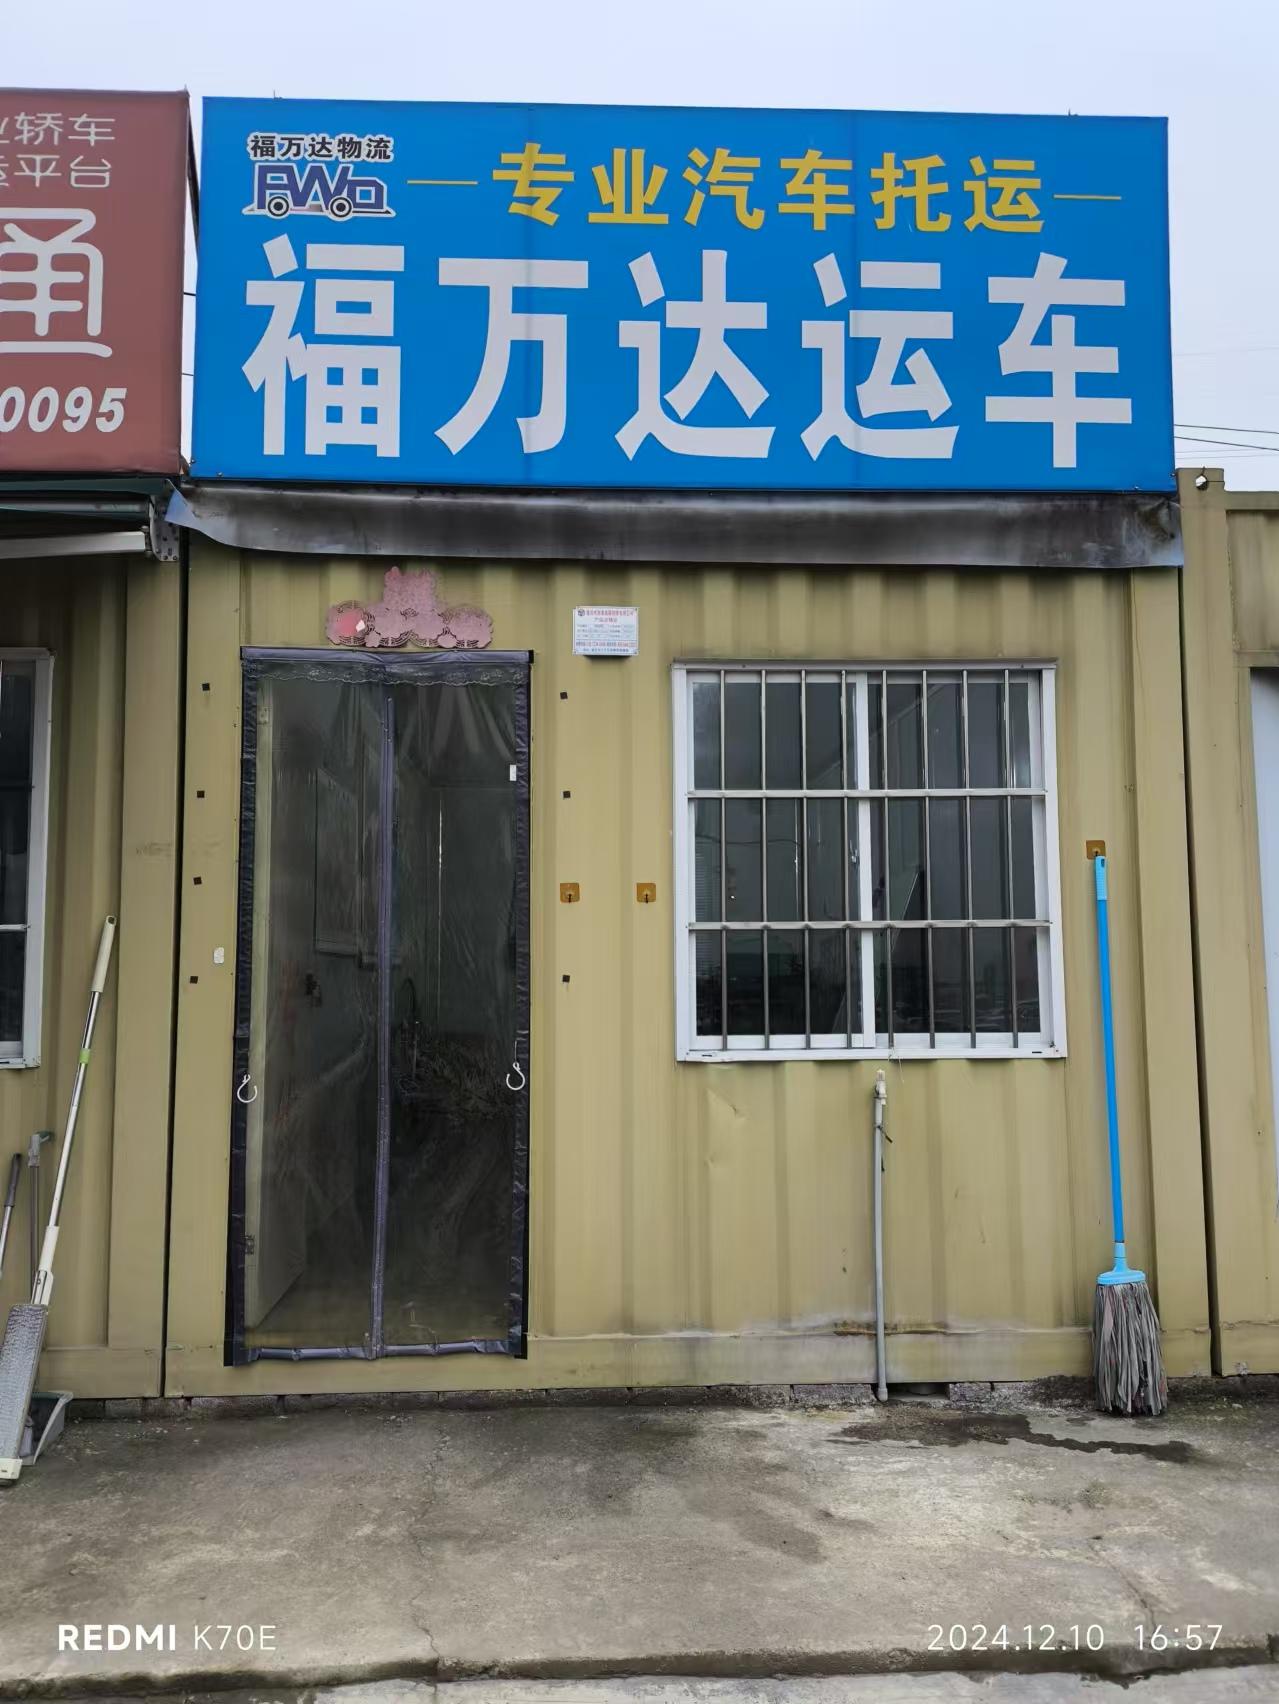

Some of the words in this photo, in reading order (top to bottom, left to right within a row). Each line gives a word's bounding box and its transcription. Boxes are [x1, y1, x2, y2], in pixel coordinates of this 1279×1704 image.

[249, 134, 391, 160] 福万达物流
[493, 143, 1043, 232] 专业汽车托运
[242, 233, 1132, 468] 福万达运车
[0, 386, 127, 433] 0095
